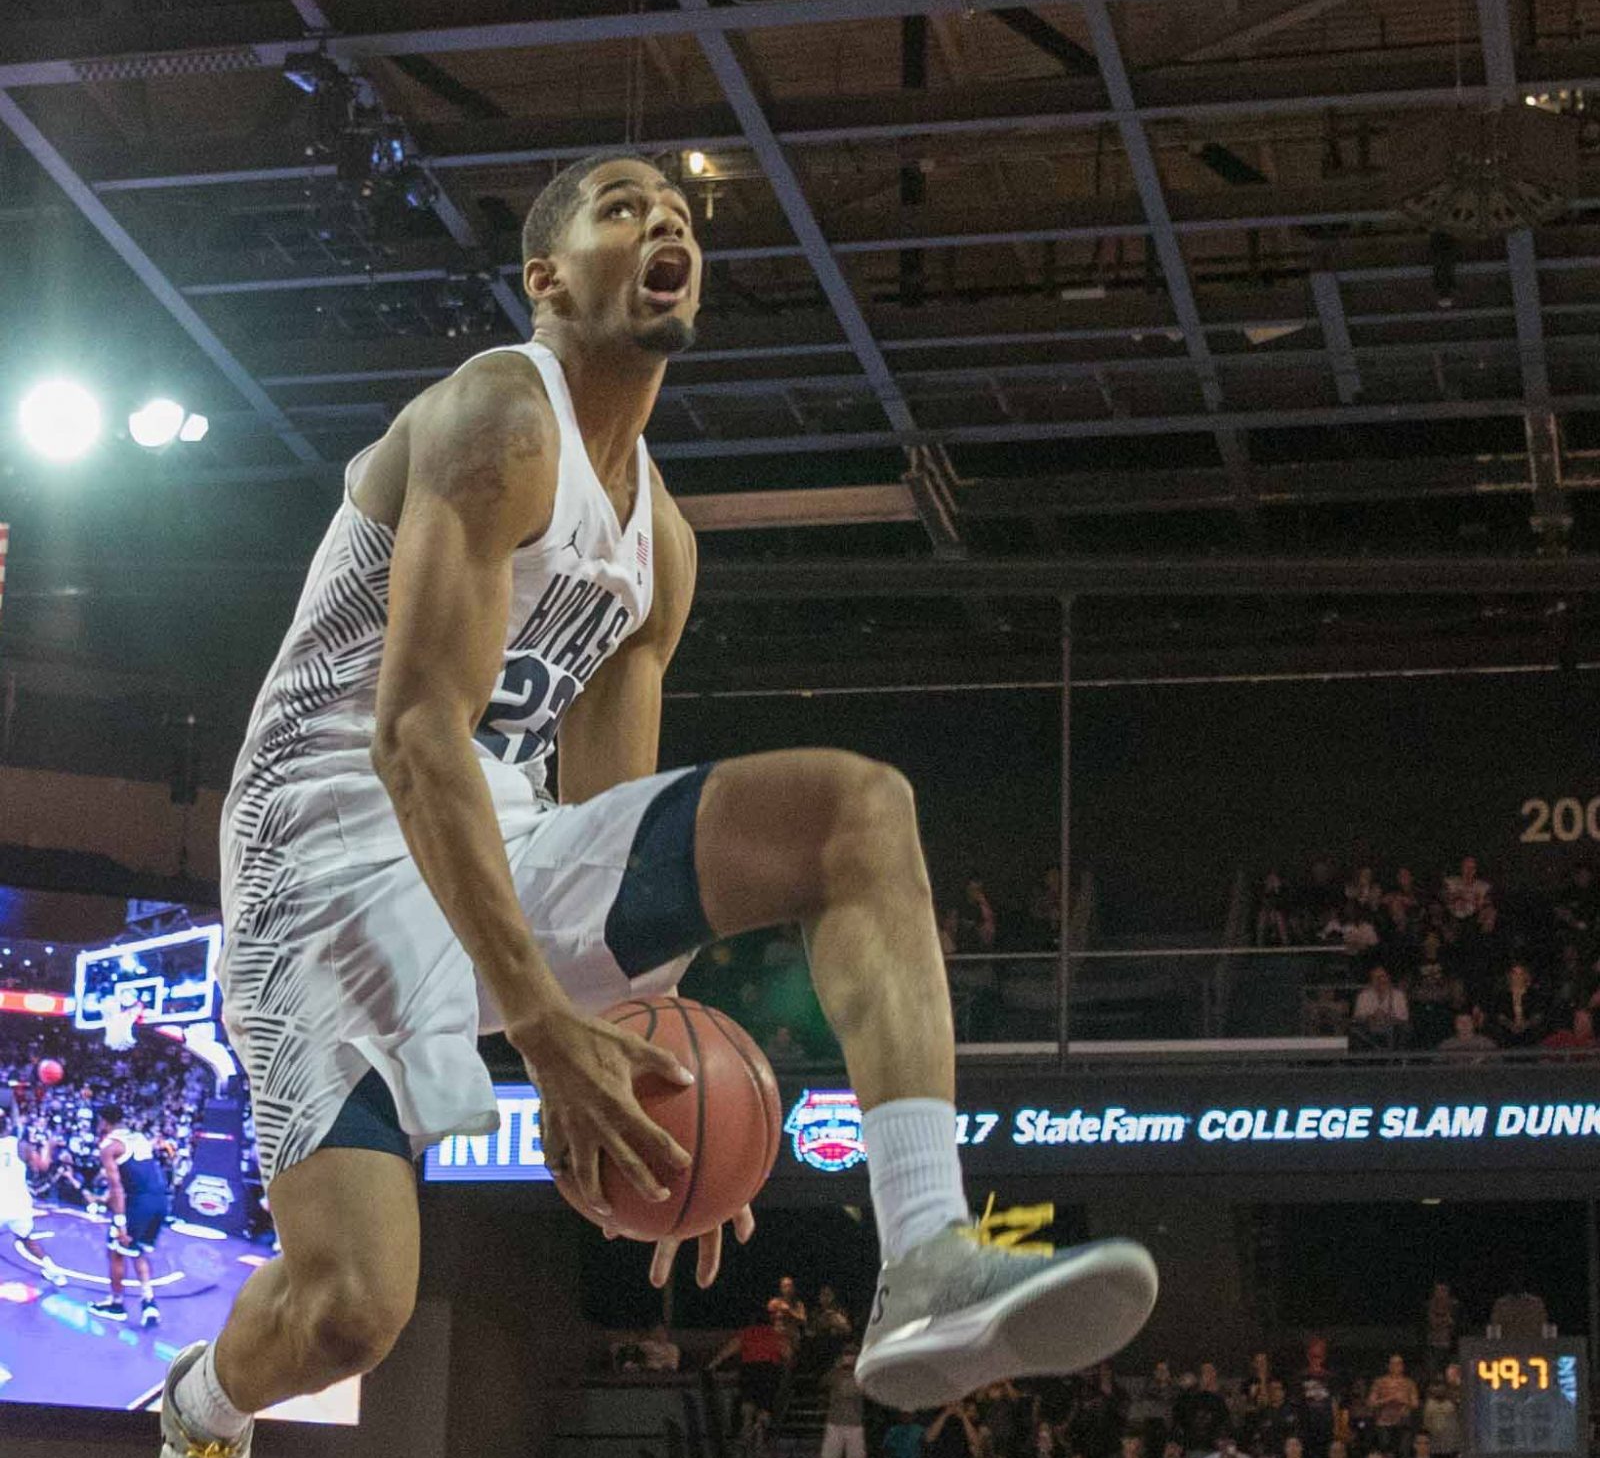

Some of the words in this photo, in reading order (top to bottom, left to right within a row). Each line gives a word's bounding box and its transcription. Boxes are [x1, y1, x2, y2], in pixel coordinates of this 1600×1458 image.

[506, 572, 630, 683] HOYAS
[1198, 1108, 1373, 1142] COLLEGE
[1379, 1105, 1489, 1139] SLAM
[1478, 1357, 1549, 1390] 49.7
